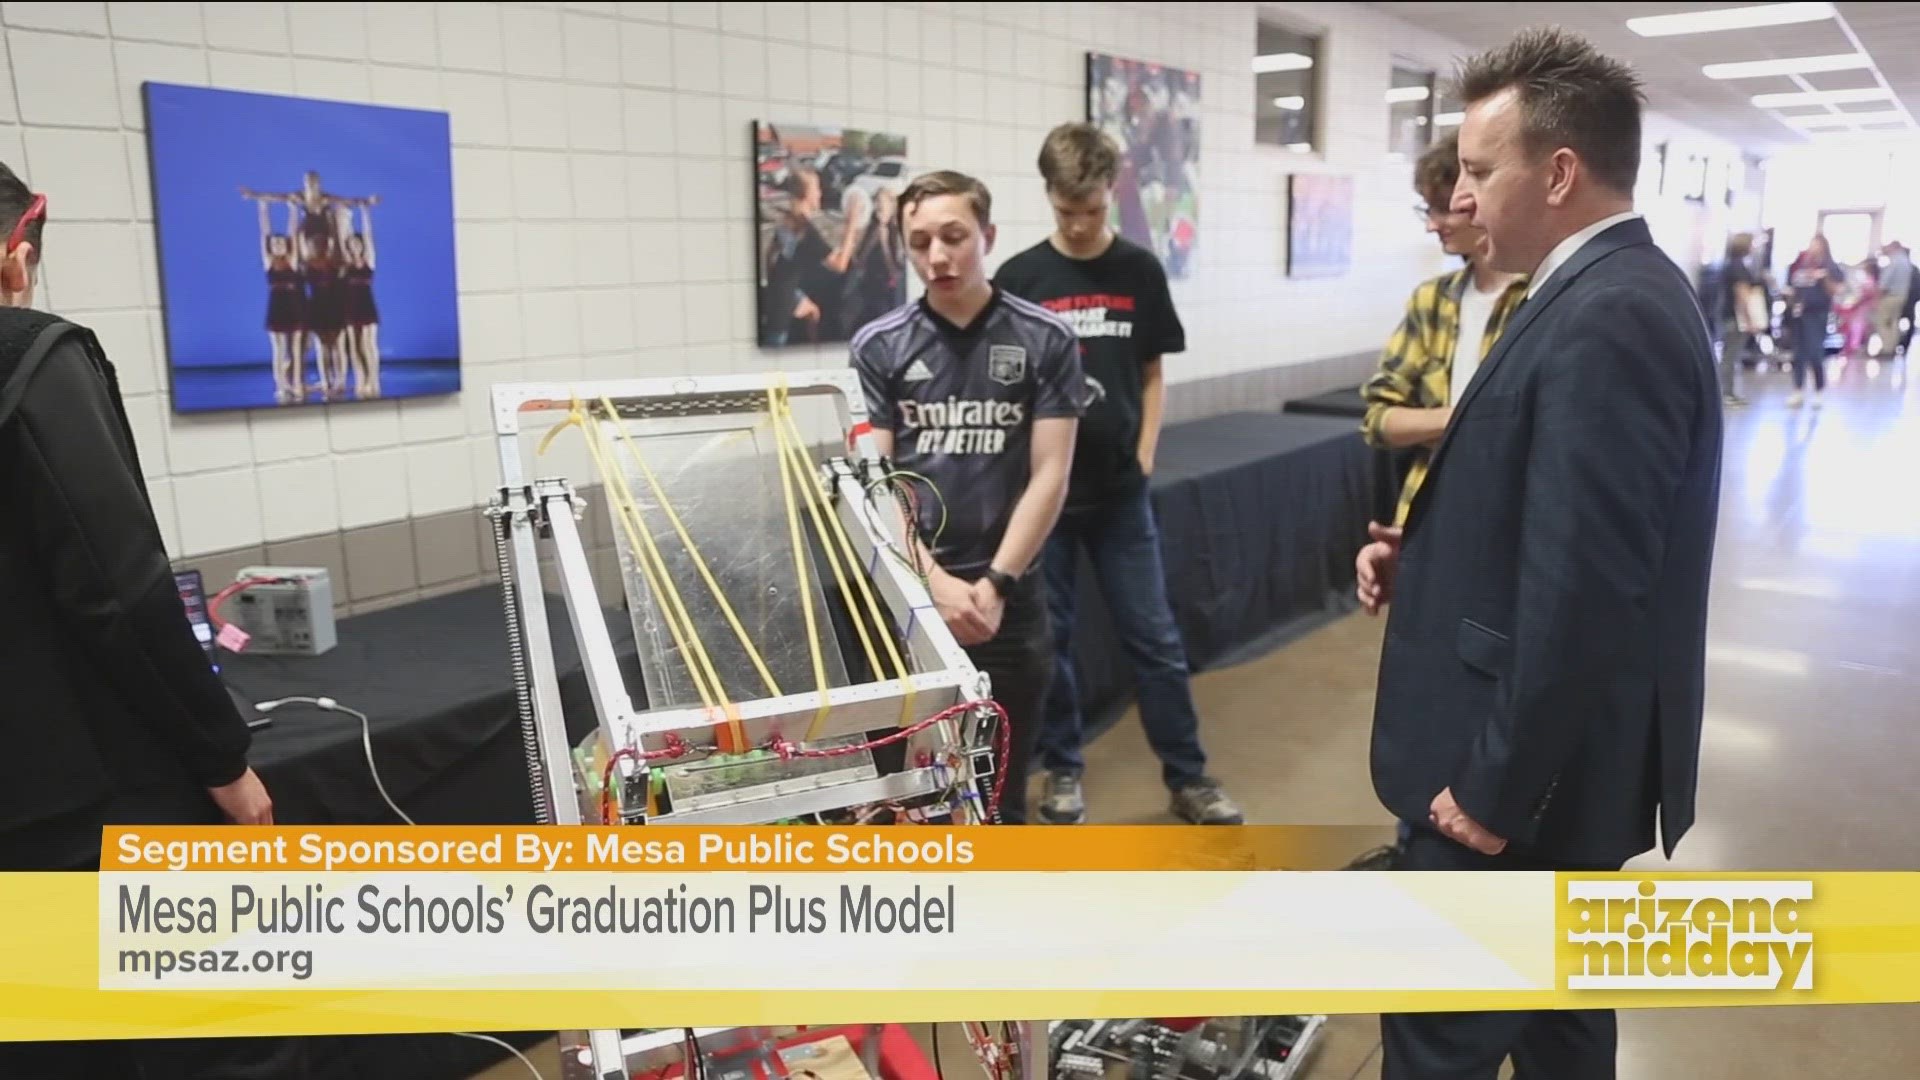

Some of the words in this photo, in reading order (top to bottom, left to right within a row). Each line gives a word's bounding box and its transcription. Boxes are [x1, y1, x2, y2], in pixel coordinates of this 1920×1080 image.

[898, 395, 1024, 428] Emirates
[916, 429, 945, 454] FLY
[944, 428, 1006, 454] BETTER
